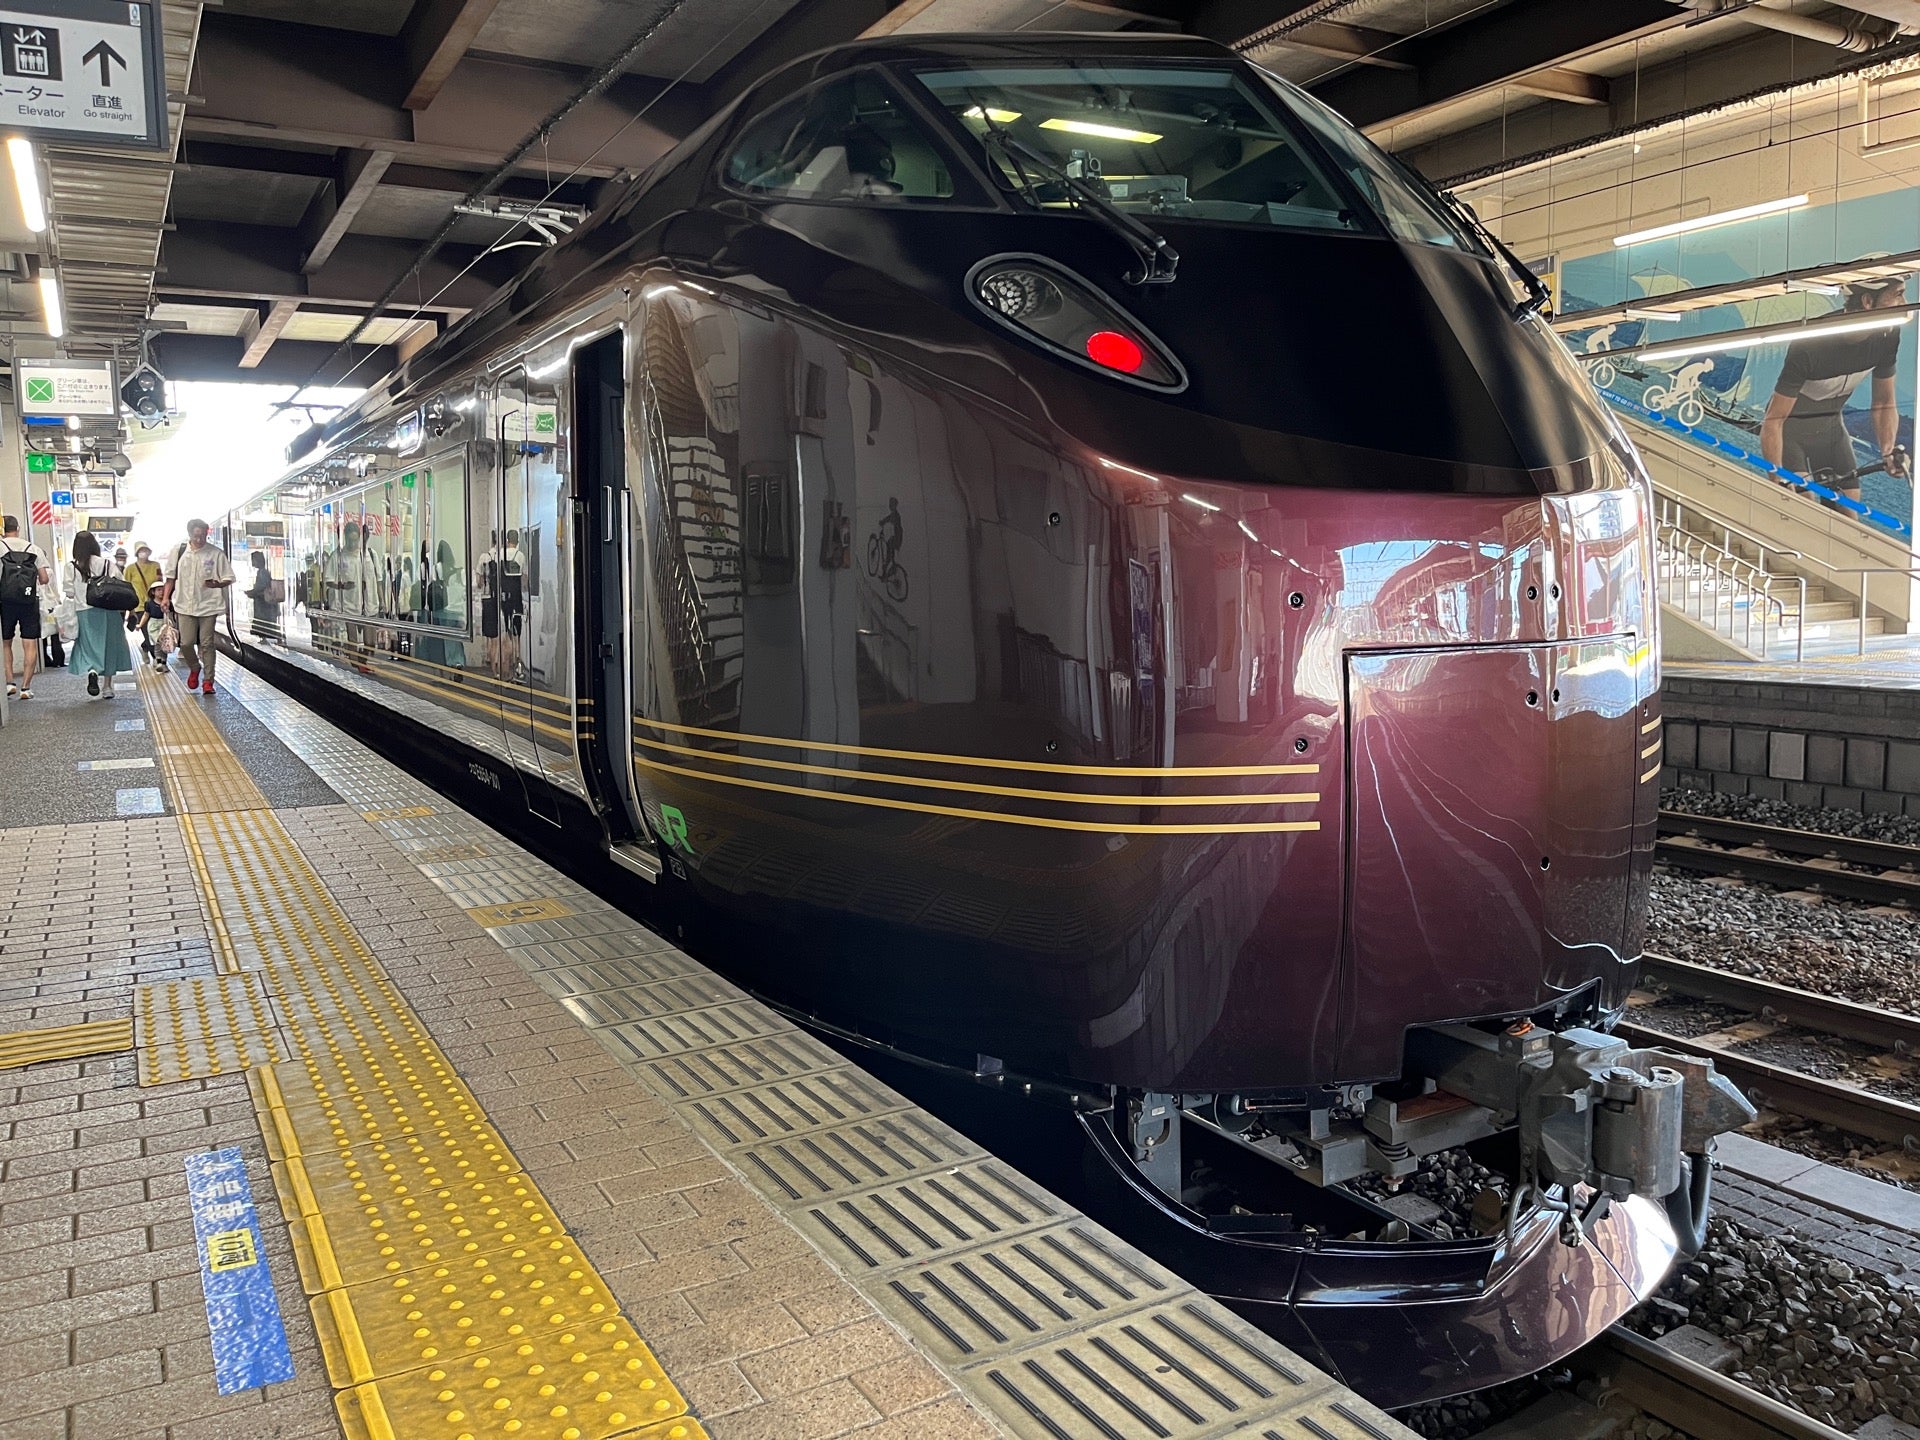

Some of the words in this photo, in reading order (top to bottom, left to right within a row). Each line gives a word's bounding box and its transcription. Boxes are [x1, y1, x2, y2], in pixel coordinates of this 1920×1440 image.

[0, 84, 64, 101] ーター
[92, 94, 122, 109] 直進
[18, 104, 65, 118] Elevator
[84, 109, 97, 117] Go
[100, 111, 132, 121] straight
[35, 457, 43, 467] 4
[57, 495, 63, 504] 6
[653, 803, 695, 854] JR
